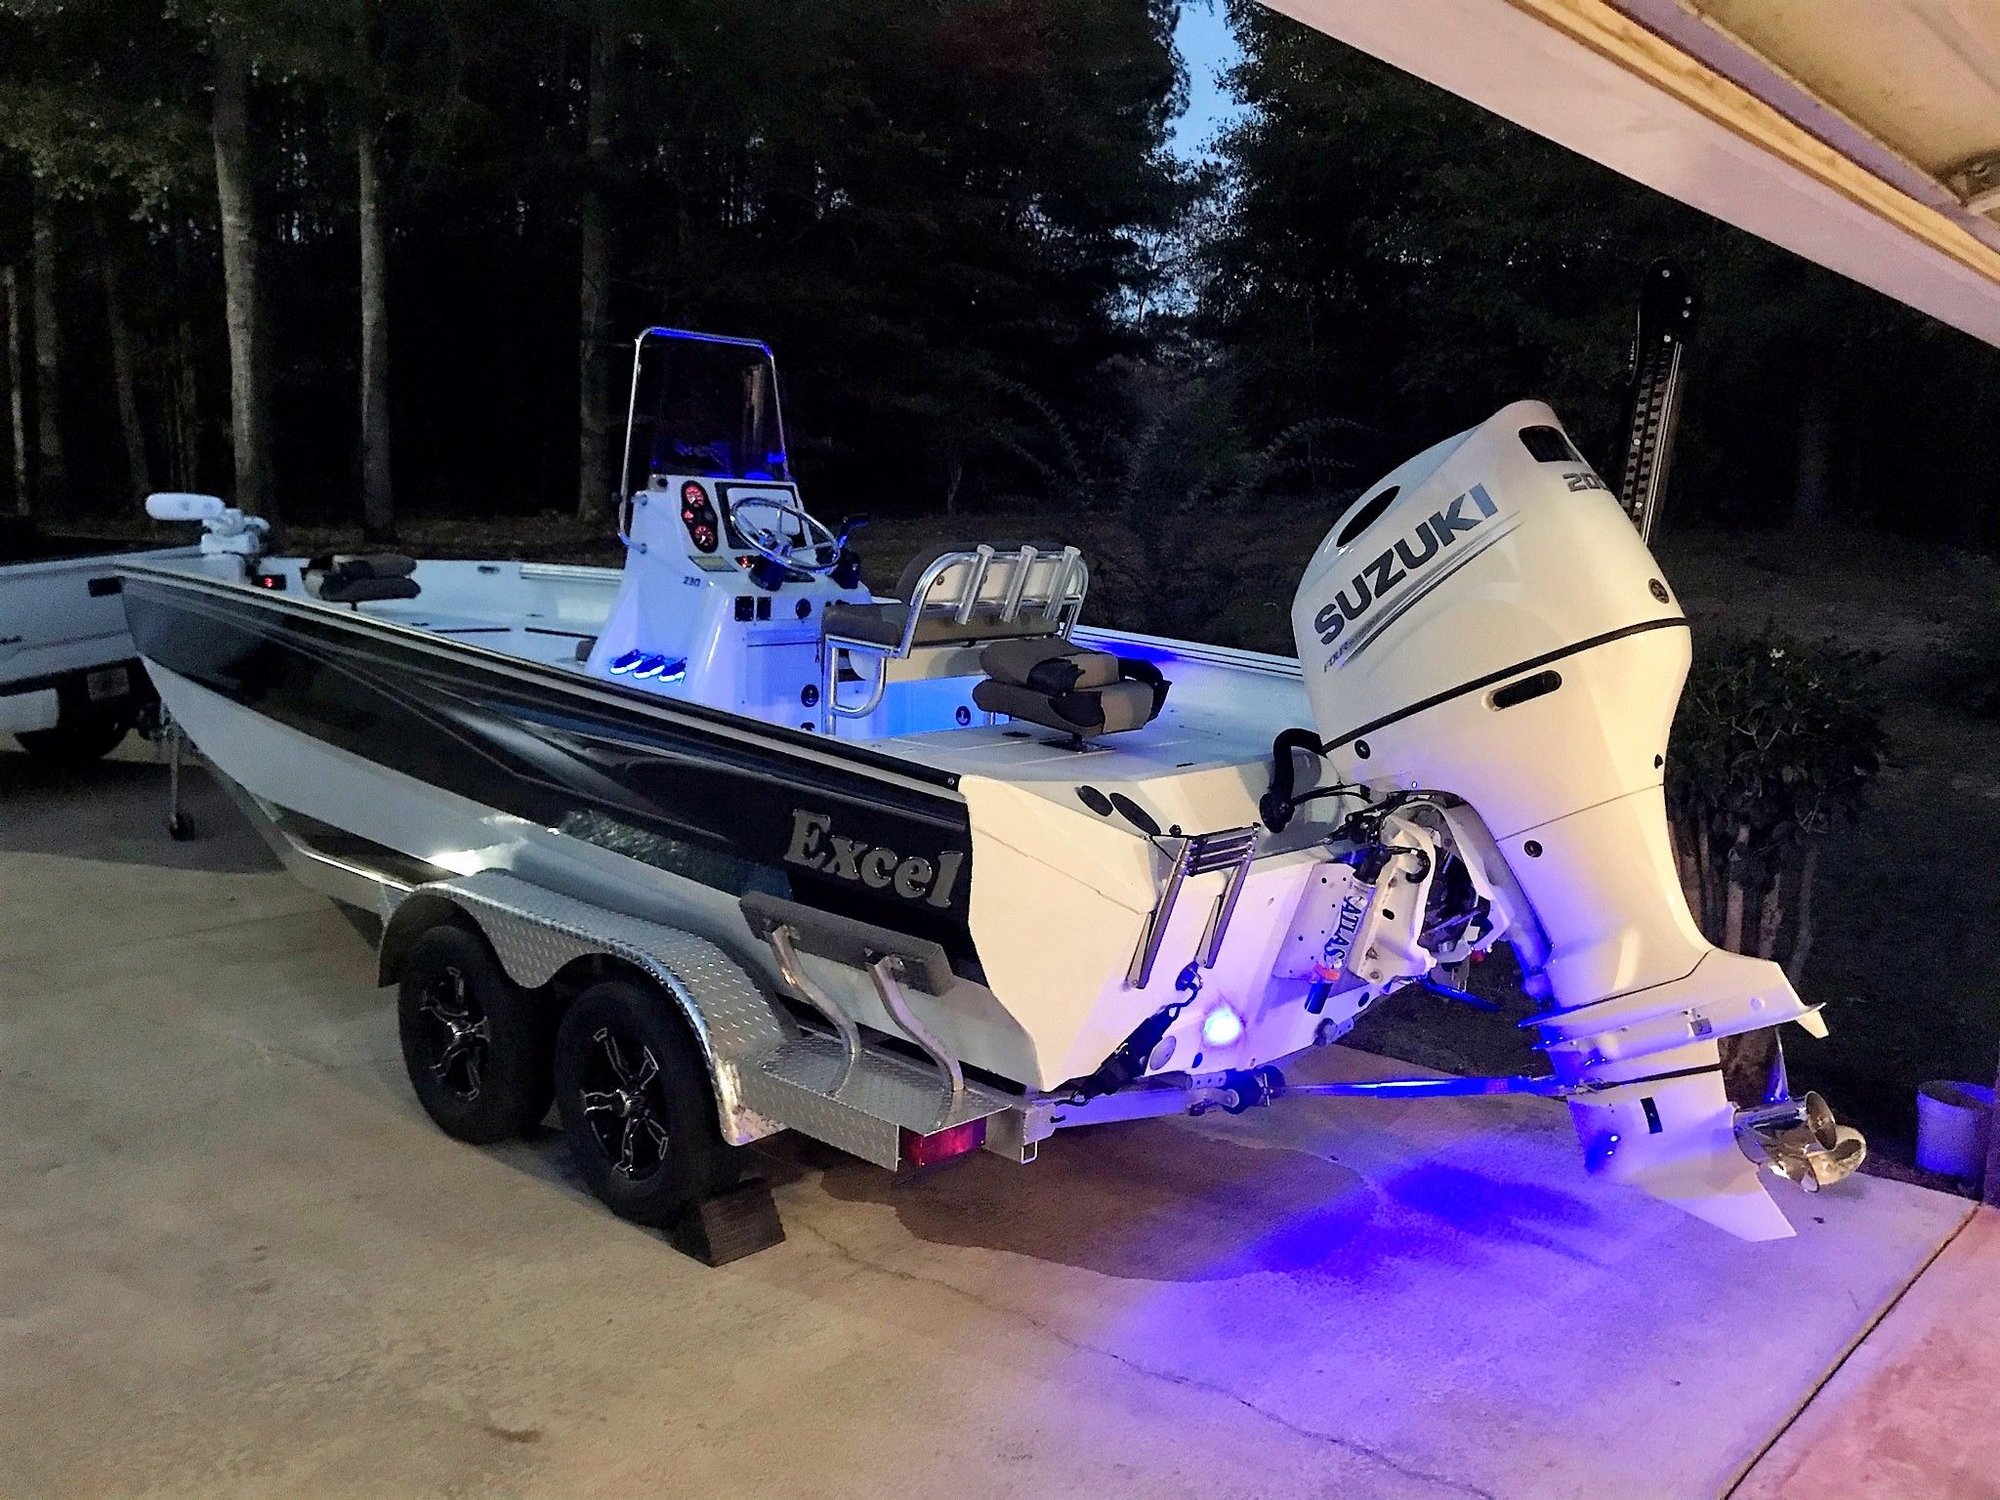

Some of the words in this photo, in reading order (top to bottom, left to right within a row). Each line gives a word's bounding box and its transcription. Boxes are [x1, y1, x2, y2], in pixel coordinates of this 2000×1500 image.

[1314, 482, 1498, 645] SUZUKI
[783, 809, 963, 908] Excel
[1323, 896, 1362, 960] ATLAS
